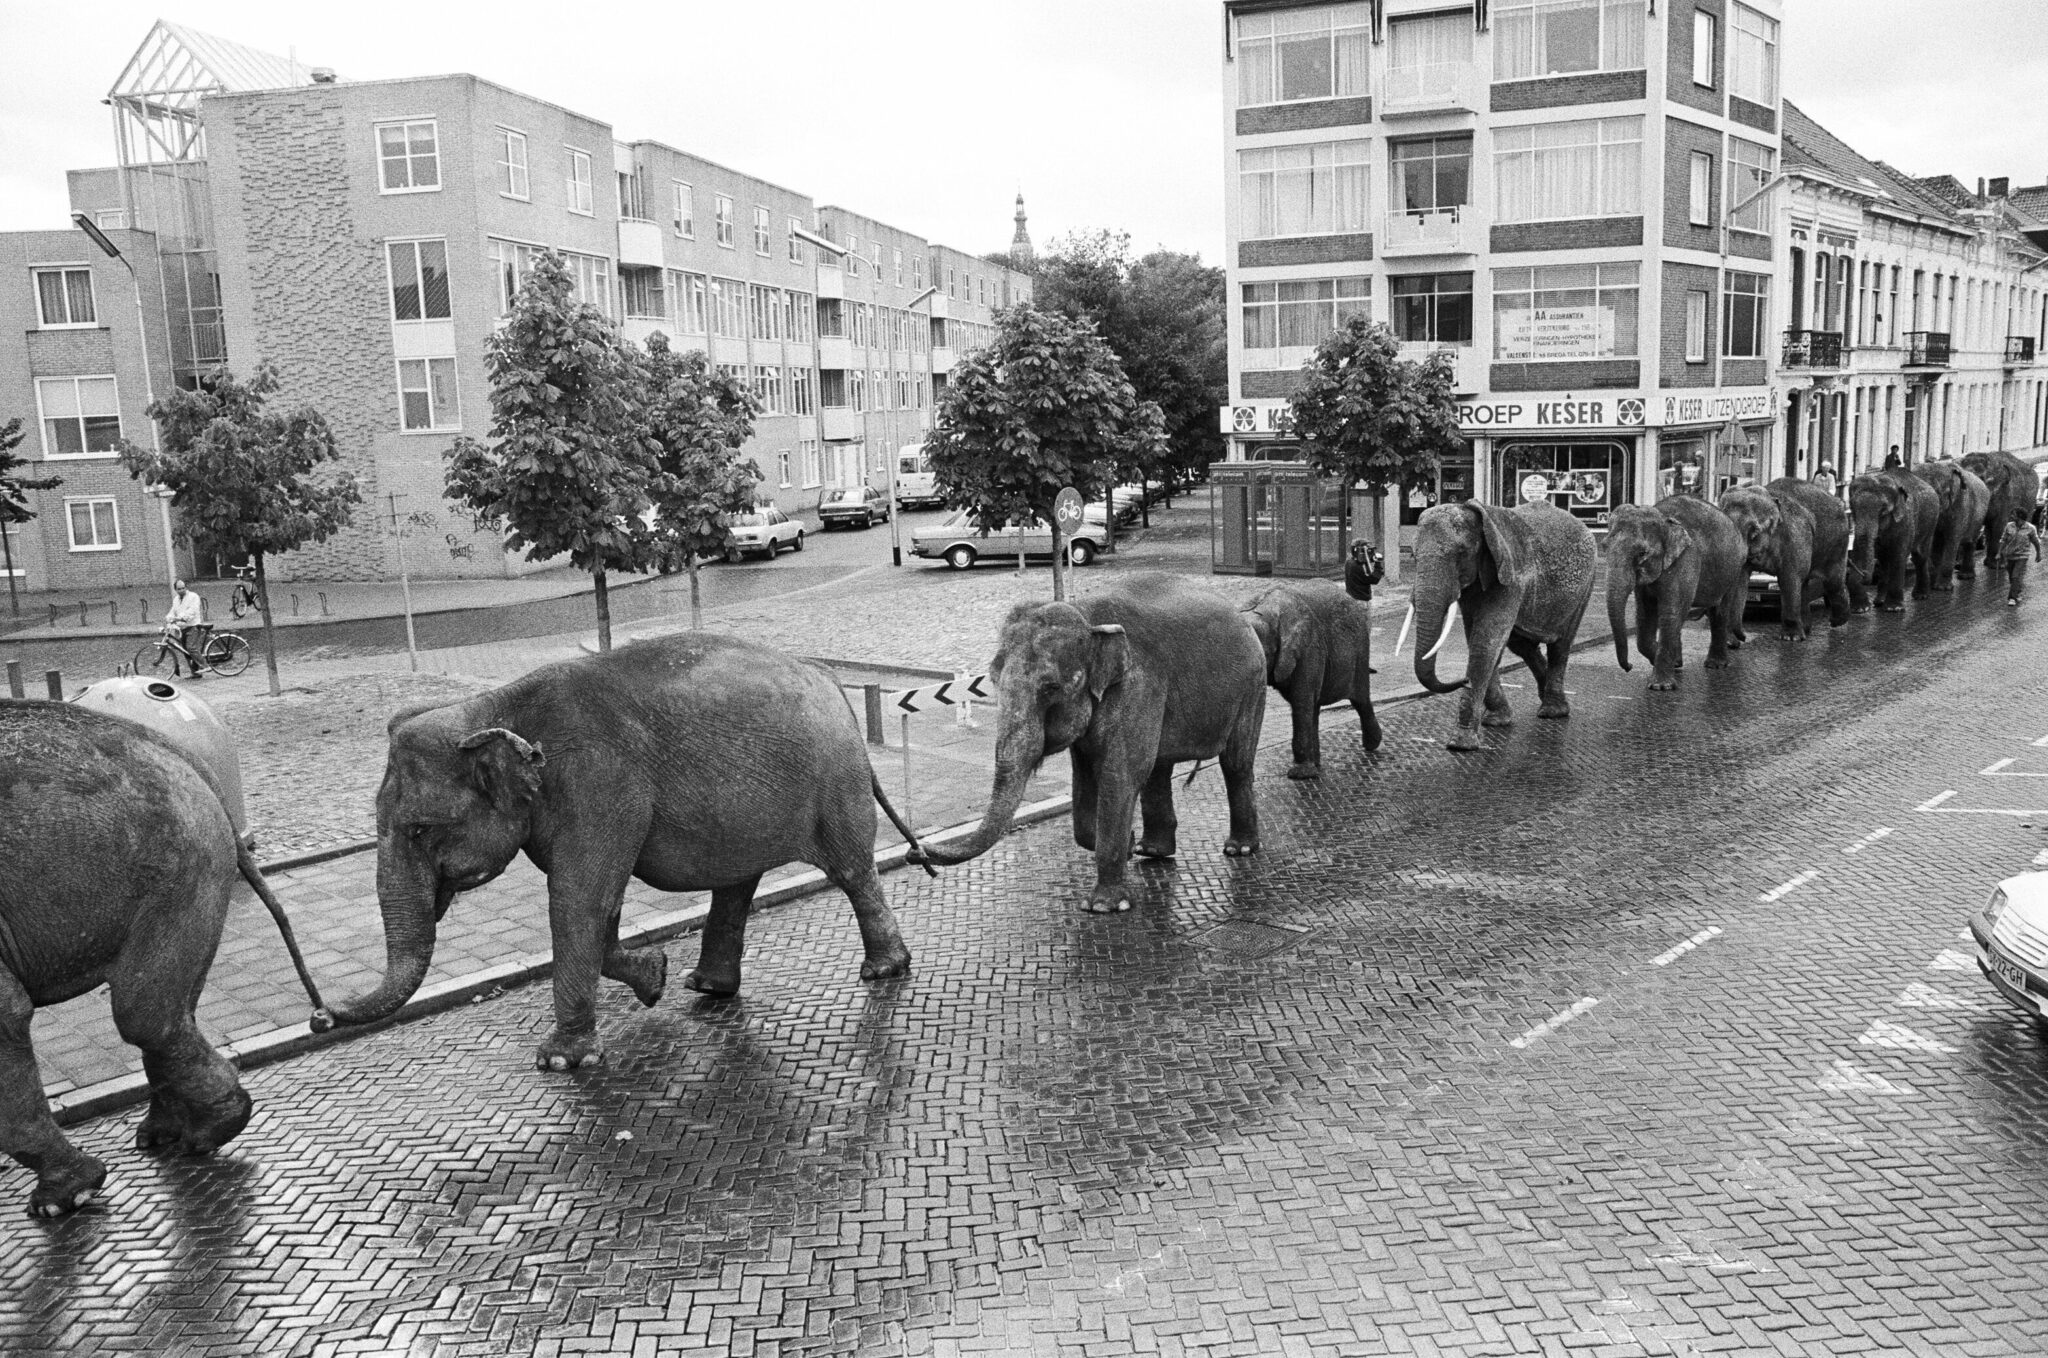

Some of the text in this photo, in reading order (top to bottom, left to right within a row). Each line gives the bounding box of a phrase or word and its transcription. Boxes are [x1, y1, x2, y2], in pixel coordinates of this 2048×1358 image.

[1535, 311, 1546, 320] AA
[1456, 404, 1523, 425] ROEP
[1537, 401, 1603, 425] KESER
[1679, 396, 1767, 421] KESER UITZENDGROEP
